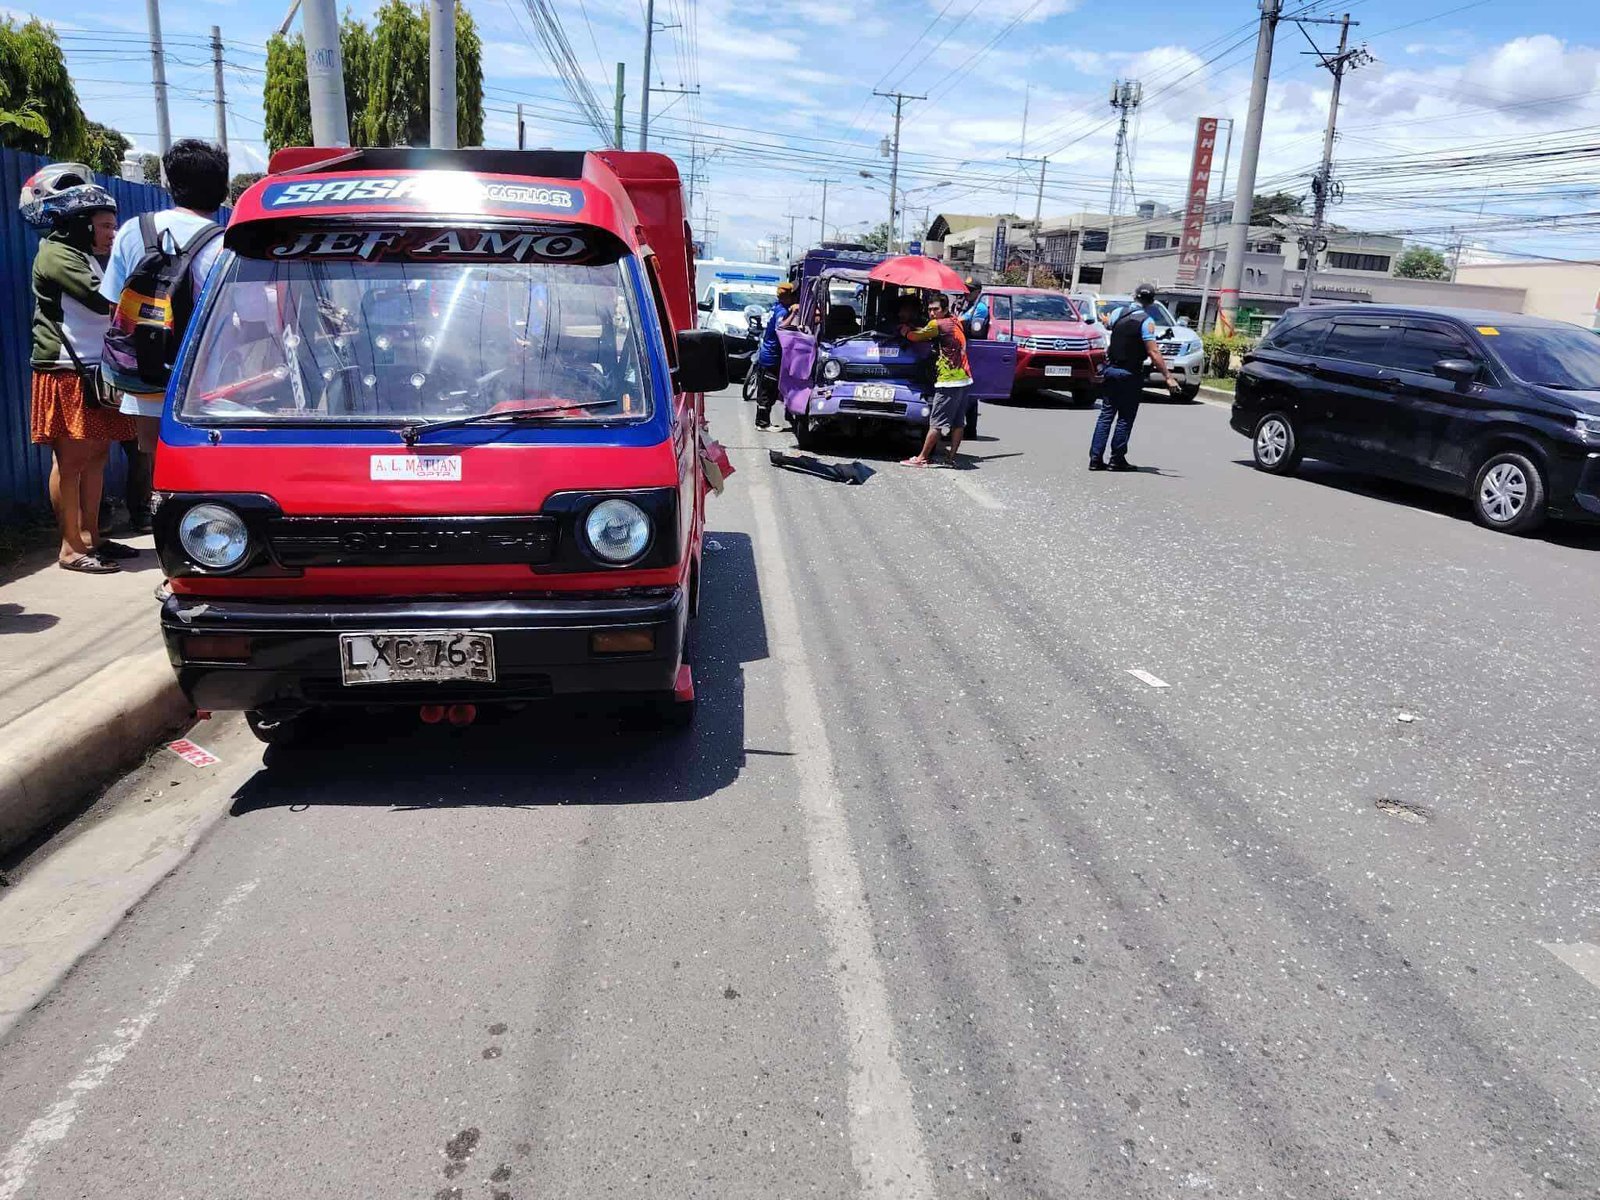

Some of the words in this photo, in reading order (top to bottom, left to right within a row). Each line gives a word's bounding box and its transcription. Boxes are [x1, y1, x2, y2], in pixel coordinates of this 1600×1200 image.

[272, 230, 406, 260] JEF
[411, 230, 587, 262] AMO
[376, 459, 388, 471] A.
[391, 459, 401, 471] L.
[405, 459, 458, 472] MATUAN
